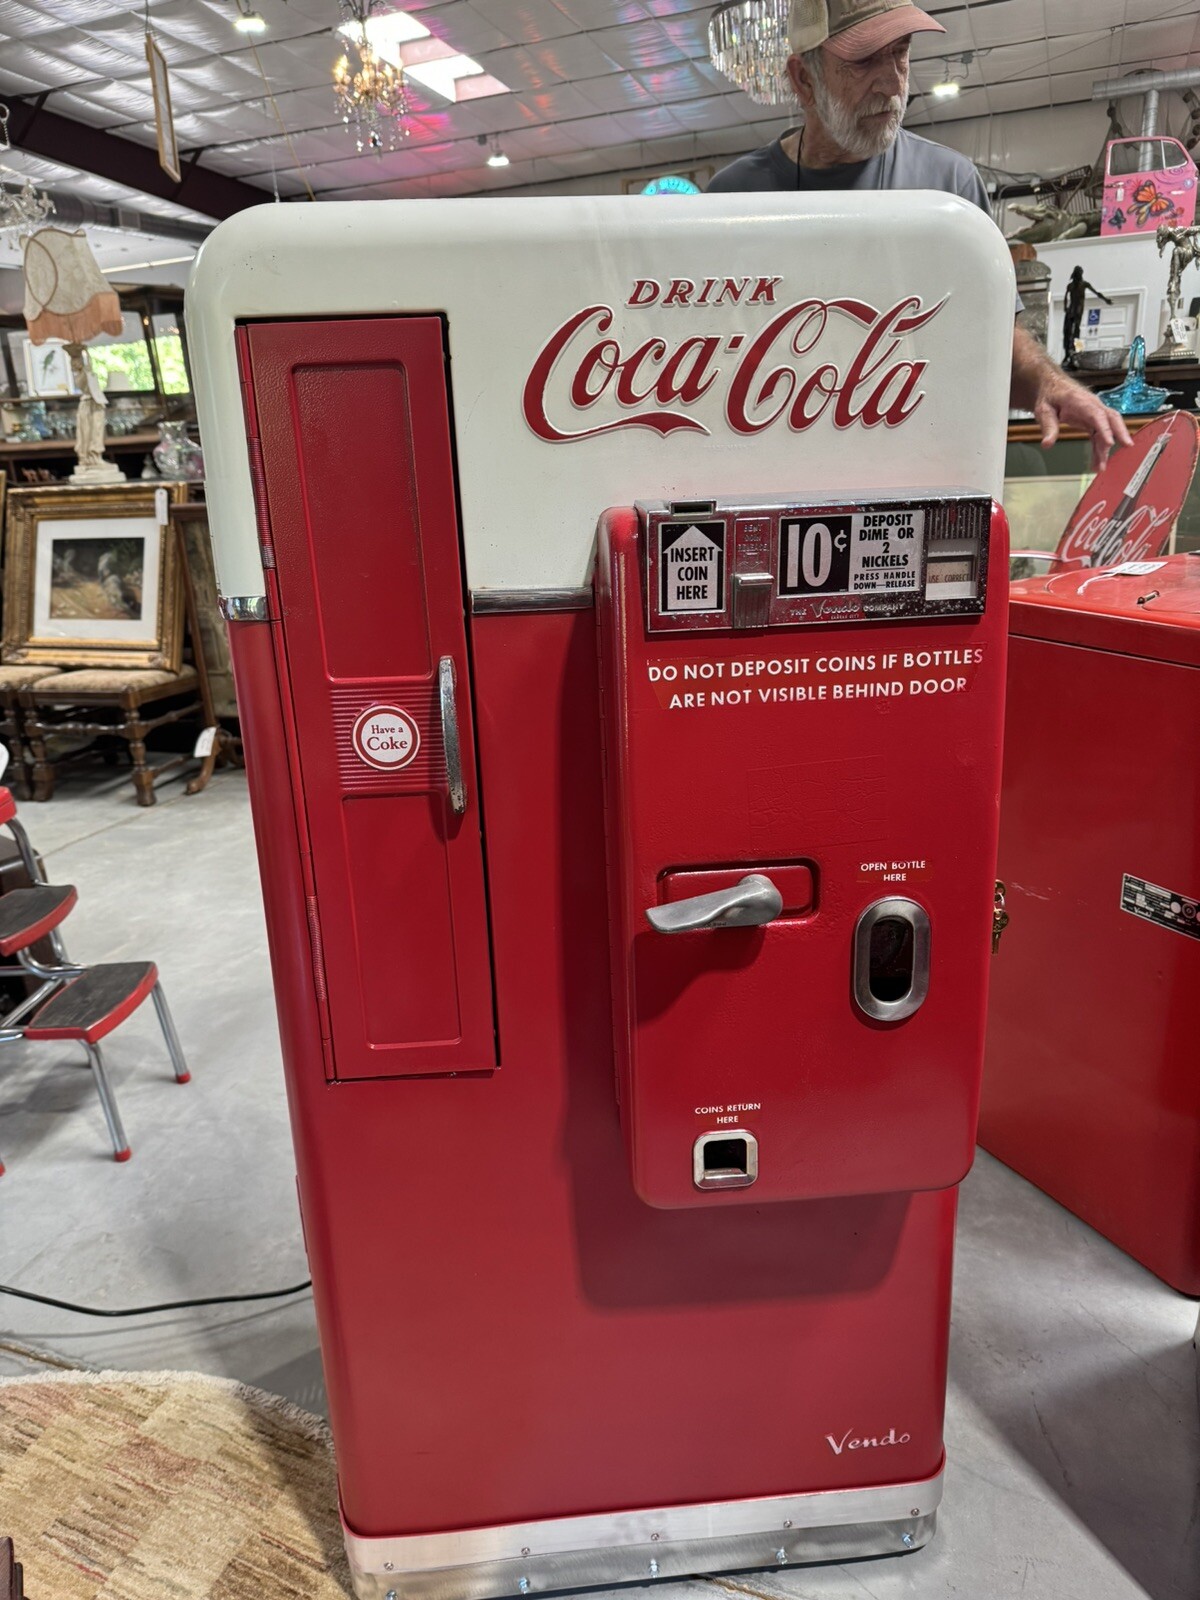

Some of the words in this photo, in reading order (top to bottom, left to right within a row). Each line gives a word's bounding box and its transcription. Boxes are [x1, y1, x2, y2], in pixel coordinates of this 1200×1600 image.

[625, 275, 783, 309] DRINK
[863, 514, 913, 528] DEPOSIT
[859, 529, 889, 541] DIME
[897, 527, 914, 539] OR
[670, 547, 715, 562] INSERT
[882, 542, 890, 553] 2
[862, 555, 908, 568] NICKELS
[677, 566, 708, 581] COIN
[854, 572, 880, 581] PRESS
[883, 571, 916, 580] HANDLE
[928, 574, 940, 583] USE
[677, 585, 708, 600] HERE
[810, 599, 860, 618] Vendo
[862, 603, 905, 613] COMPANY
[648, 666, 678, 682] DO
[684, 663, 725, 679] NOT
[731, 658, 810, 677] DEPOSIT
[815, 655, 876, 672] COINS
[882, 654, 898, 669] IF
[903, 649, 983, 668] BOTTLES
[669, 692, 706, 709] ARE
[711, 690, 752, 706] NOT
[758, 686, 827, 702] VISIBLE
[832, 681, 904, 699] BEHIND
[909, 677, 967, 695] DOOR
[371, 724, 395, 734] Have
[366, 736, 408, 751] Coke
[860, 862, 888, 872] OPEN
[891, 860, 926, 870] BOTTLE
[883, 873, 907, 882] HERE
[694, 1105, 724, 1115] COINS
[726, 1103, 761, 1112] RETURN
[716, 1115, 739, 1124] HERE
[825, 1427, 911, 1456] Vendo
